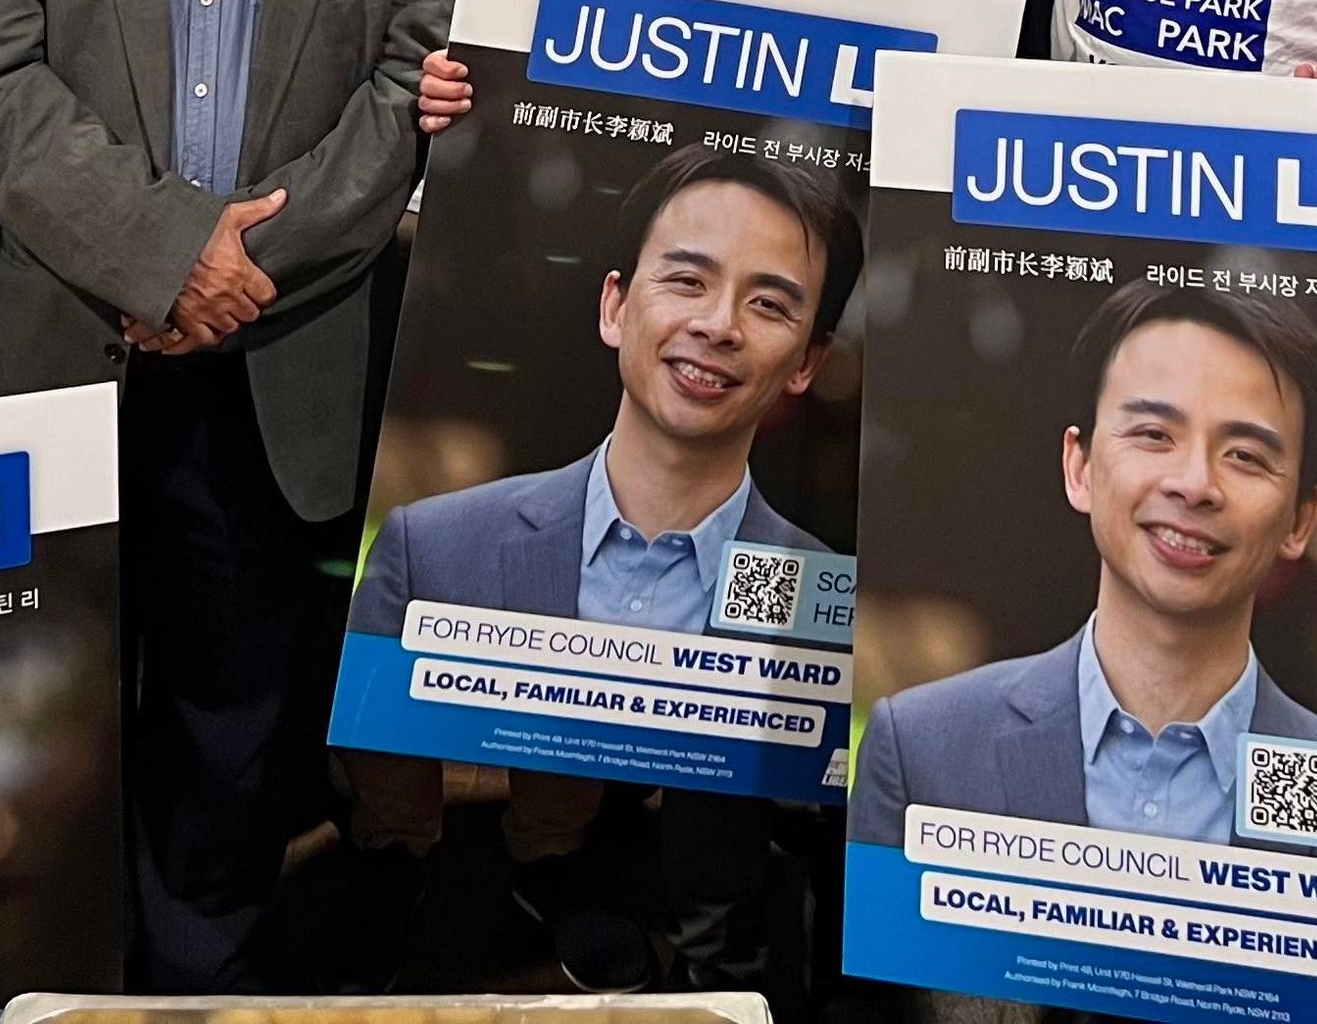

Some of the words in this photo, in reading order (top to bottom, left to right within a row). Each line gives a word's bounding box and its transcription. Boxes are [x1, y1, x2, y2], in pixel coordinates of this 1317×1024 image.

[545, 5, 810, 98] JUSTIN
[829, 44, 875, 109] L
[1157, 18, 1260, 63] PARK
[512, 101, 675, 147] 前副市长李颖斌
[703, 130, 757, 156] 라이드
[763, 139, 781, 161] 전
[786, 143, 841, 169] 부시장
[966, 136, 1244, 221] JUSTIN
[943, 245, 1114, 285] 前副市长李颖斌
[1146, 264, 1206, 290] 라이드
[1213, 270, 1231, 293] 전
[1237, 271, 1299, 298] 부시장
[20, 588, 40, 611] 리
[417, 615, 470, 642] FOR
[476, 623, 544, 652] RYDE
[549, 630, 663, 667] COUNCIL
[672, 647, 752, 675] WEST
[758, 658, 841, 687] WARD
[423, 671, 508, 699] LOCAL,
[514, 682, 626, 711] FAMILIAR
[630, 696, 647, 713] &
[652, 698, 815, 734] EXPERIENCED
[919, 822, 976, 851] FOR
[982, 830, 1056, 864] RYDE
[1062, 841, 1190, 882] COUNCIL
[1198, 859, 1292, 895] WEST
[933, 886, 1027, 923] LOCAL,
[1032, 901, 1155, 936] FAMILIAR
[1161, 918, 1180, 940] &
